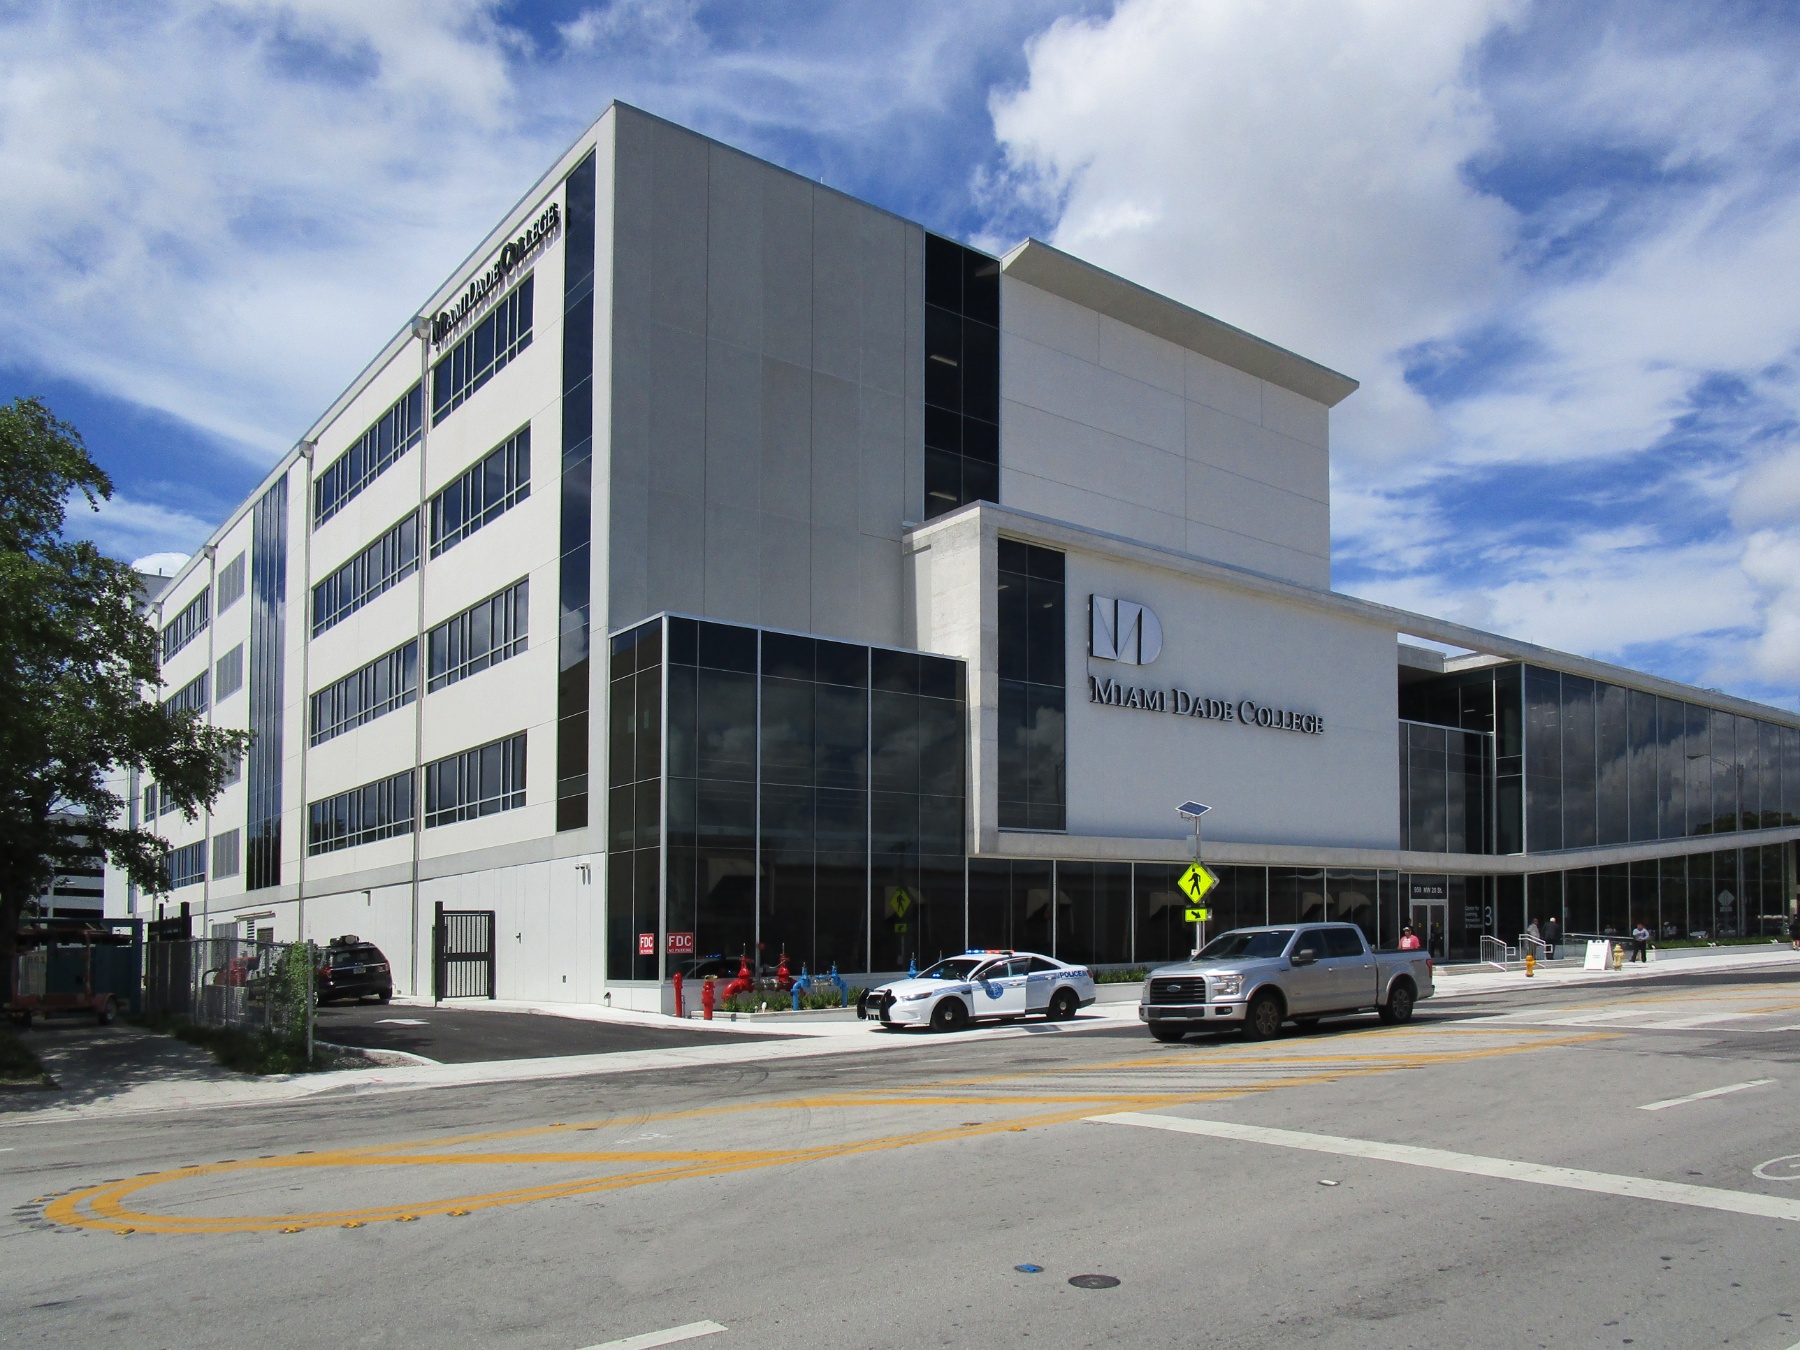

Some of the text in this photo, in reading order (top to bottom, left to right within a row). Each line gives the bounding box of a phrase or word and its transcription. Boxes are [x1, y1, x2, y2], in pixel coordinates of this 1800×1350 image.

[1089, 675, 1324, 735] MIAMI DADE COLLEGE
[1485, 905, 1493, 926] 3
[640, 936, 653, 948] FDC
[668, 935, 692, 947] FDC
[1059, 970, 1082, 978] POLICE
